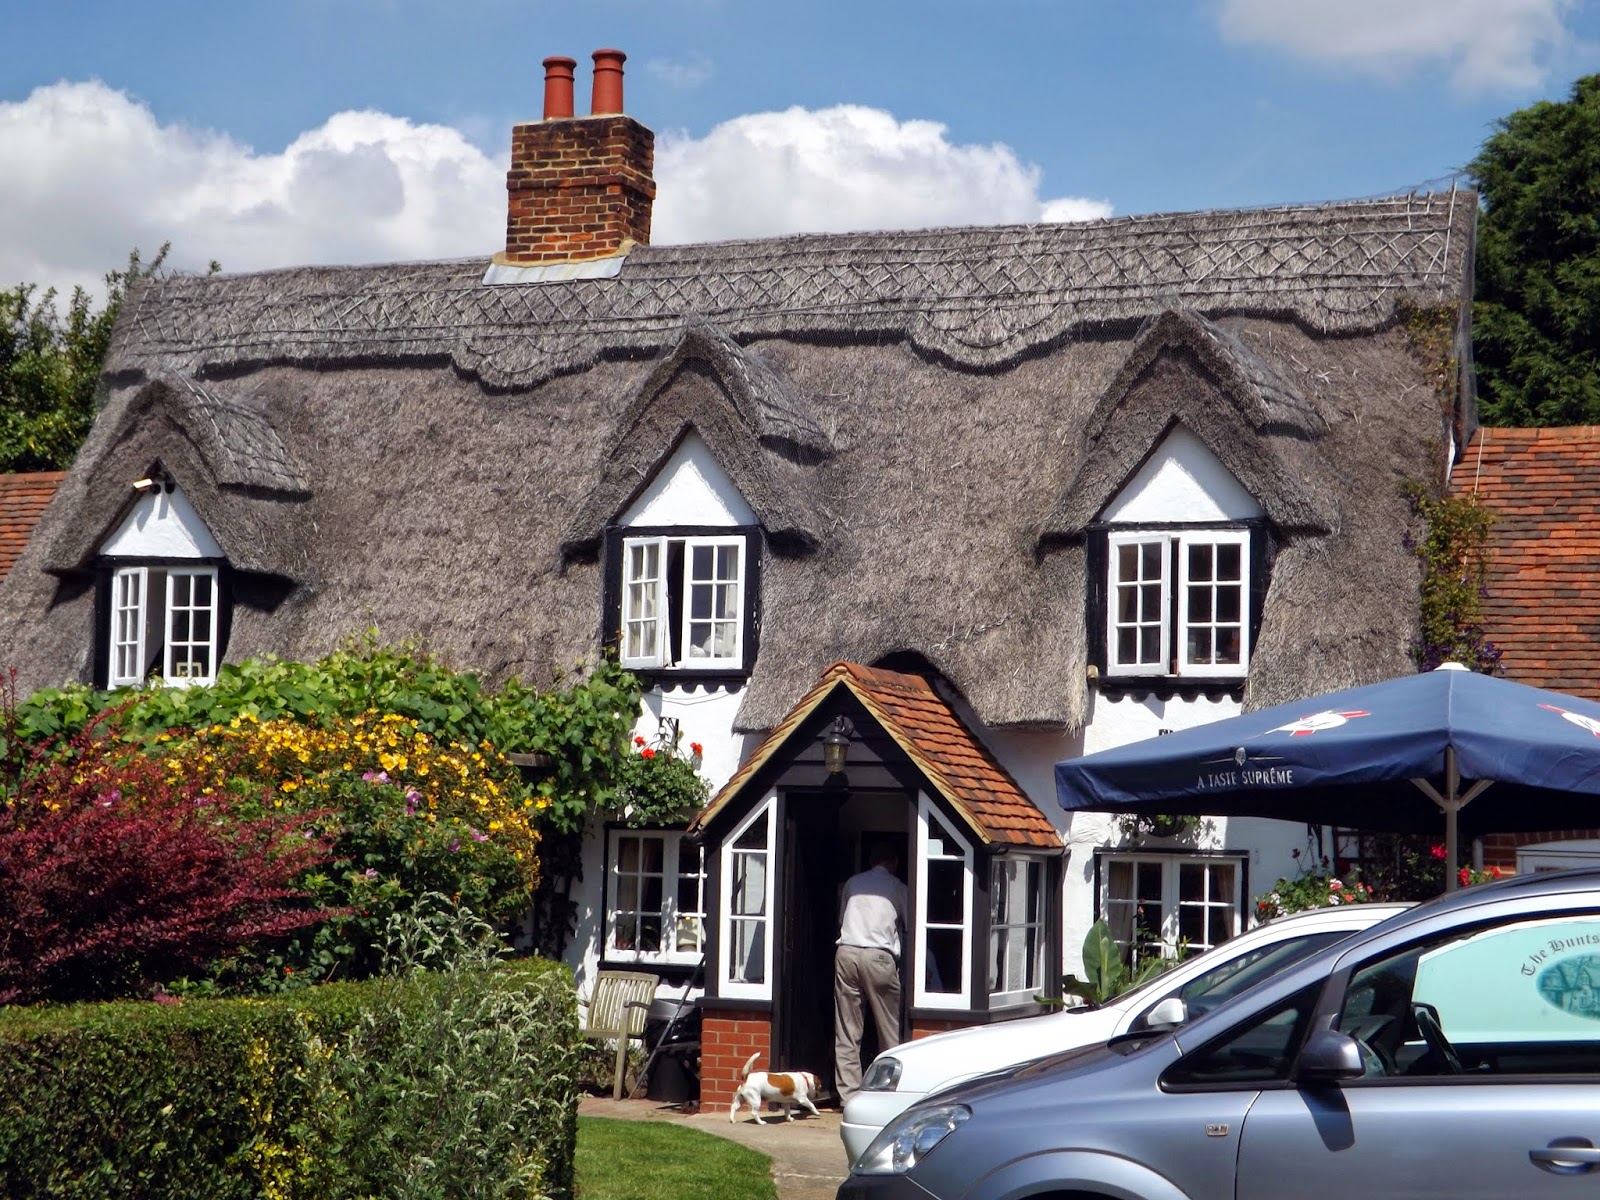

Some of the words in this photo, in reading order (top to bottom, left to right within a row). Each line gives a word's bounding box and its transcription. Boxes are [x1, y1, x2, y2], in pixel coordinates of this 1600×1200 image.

[1197, 777, 1205, 789] A
[1208, 772, 1237, 787] TASTE
[1241, 767, 1293, 784] SUPRÊME
[1521, 950, 1548, 976] The
